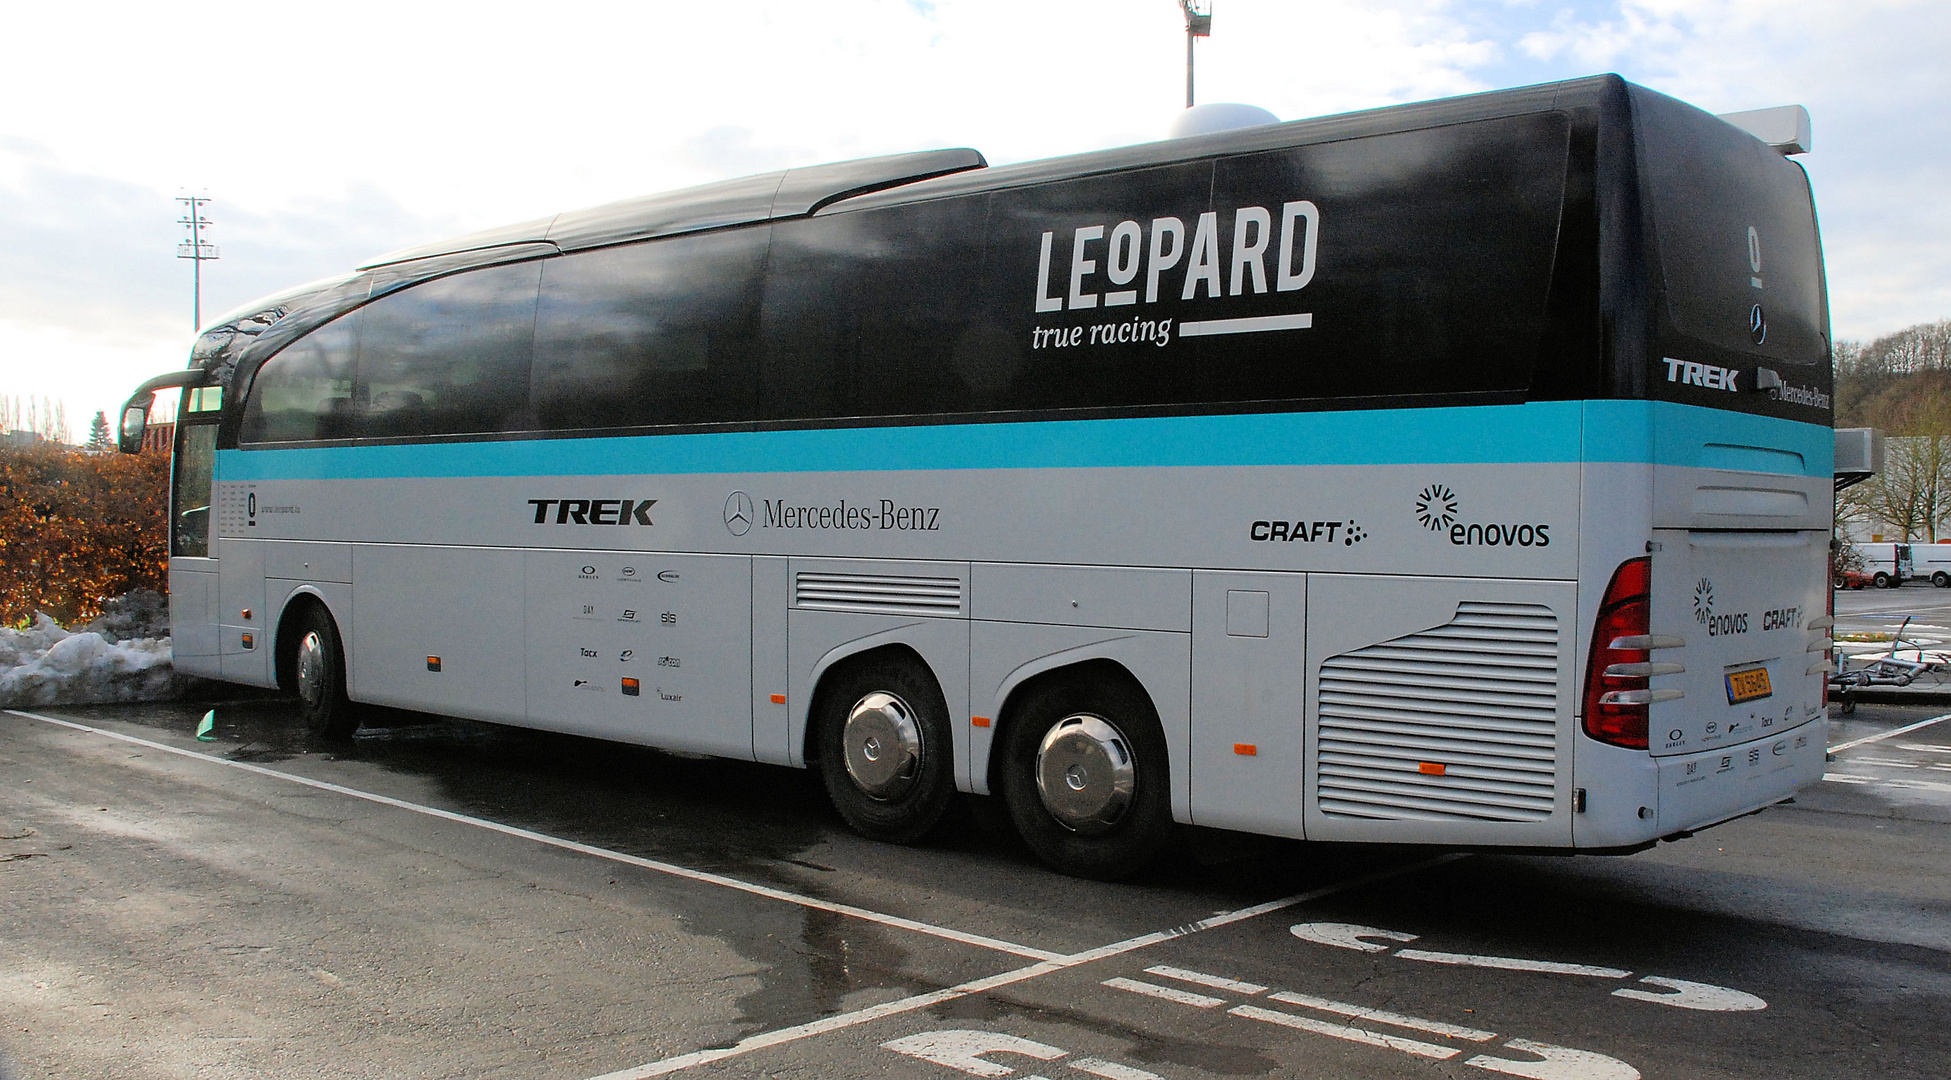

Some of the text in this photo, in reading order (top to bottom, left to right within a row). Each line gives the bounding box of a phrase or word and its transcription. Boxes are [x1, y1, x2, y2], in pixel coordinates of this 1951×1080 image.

[1035, 200, 1319, 313] LEOPARD
[1033, 316, 1172, 350] true racing
[1663, 357, 1740, 392] TREK
[1778, 379, 1830, 410] Mercedes-Benz
[527, 499, 659, 526] TREK
[762, 499, 940, 531] Mercedes-Benz
[1250, 520, 1342, 542] CRAFT
[1450, 523, 1550, 547] enovos
[1708, 612, 1748, 637] enovos
[1763, 607, 1797, 631] CRAFT
[580, 647, 598, 658] Tacx
[661, 692, 682, 702] Luxair
